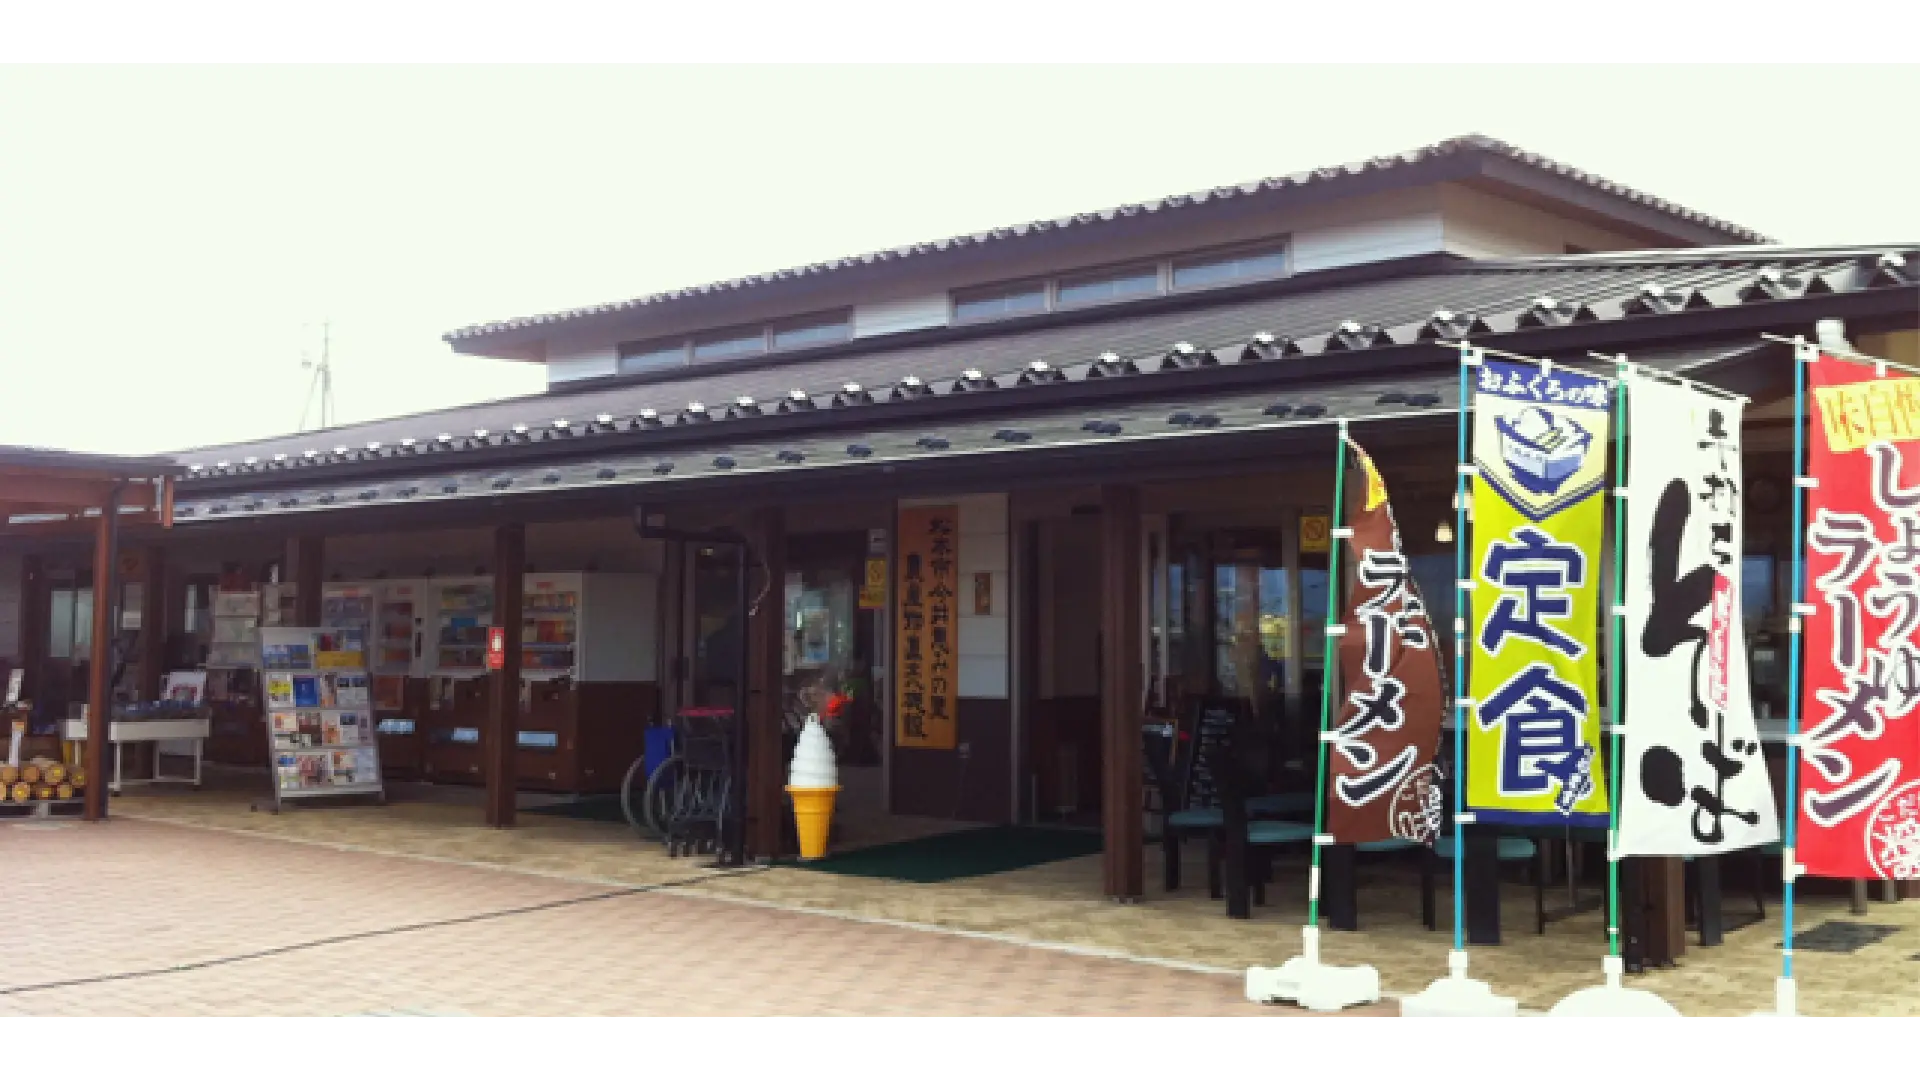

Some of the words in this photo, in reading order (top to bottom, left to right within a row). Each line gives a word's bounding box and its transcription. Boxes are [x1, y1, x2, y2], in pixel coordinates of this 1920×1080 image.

[1334, 546, 1419, 808] ラーメン
[1476, 525, 1592, 798] 定食
[1639, 476, 1762, 845] そば
[1803, 507, 1902, 827] ラーメン
